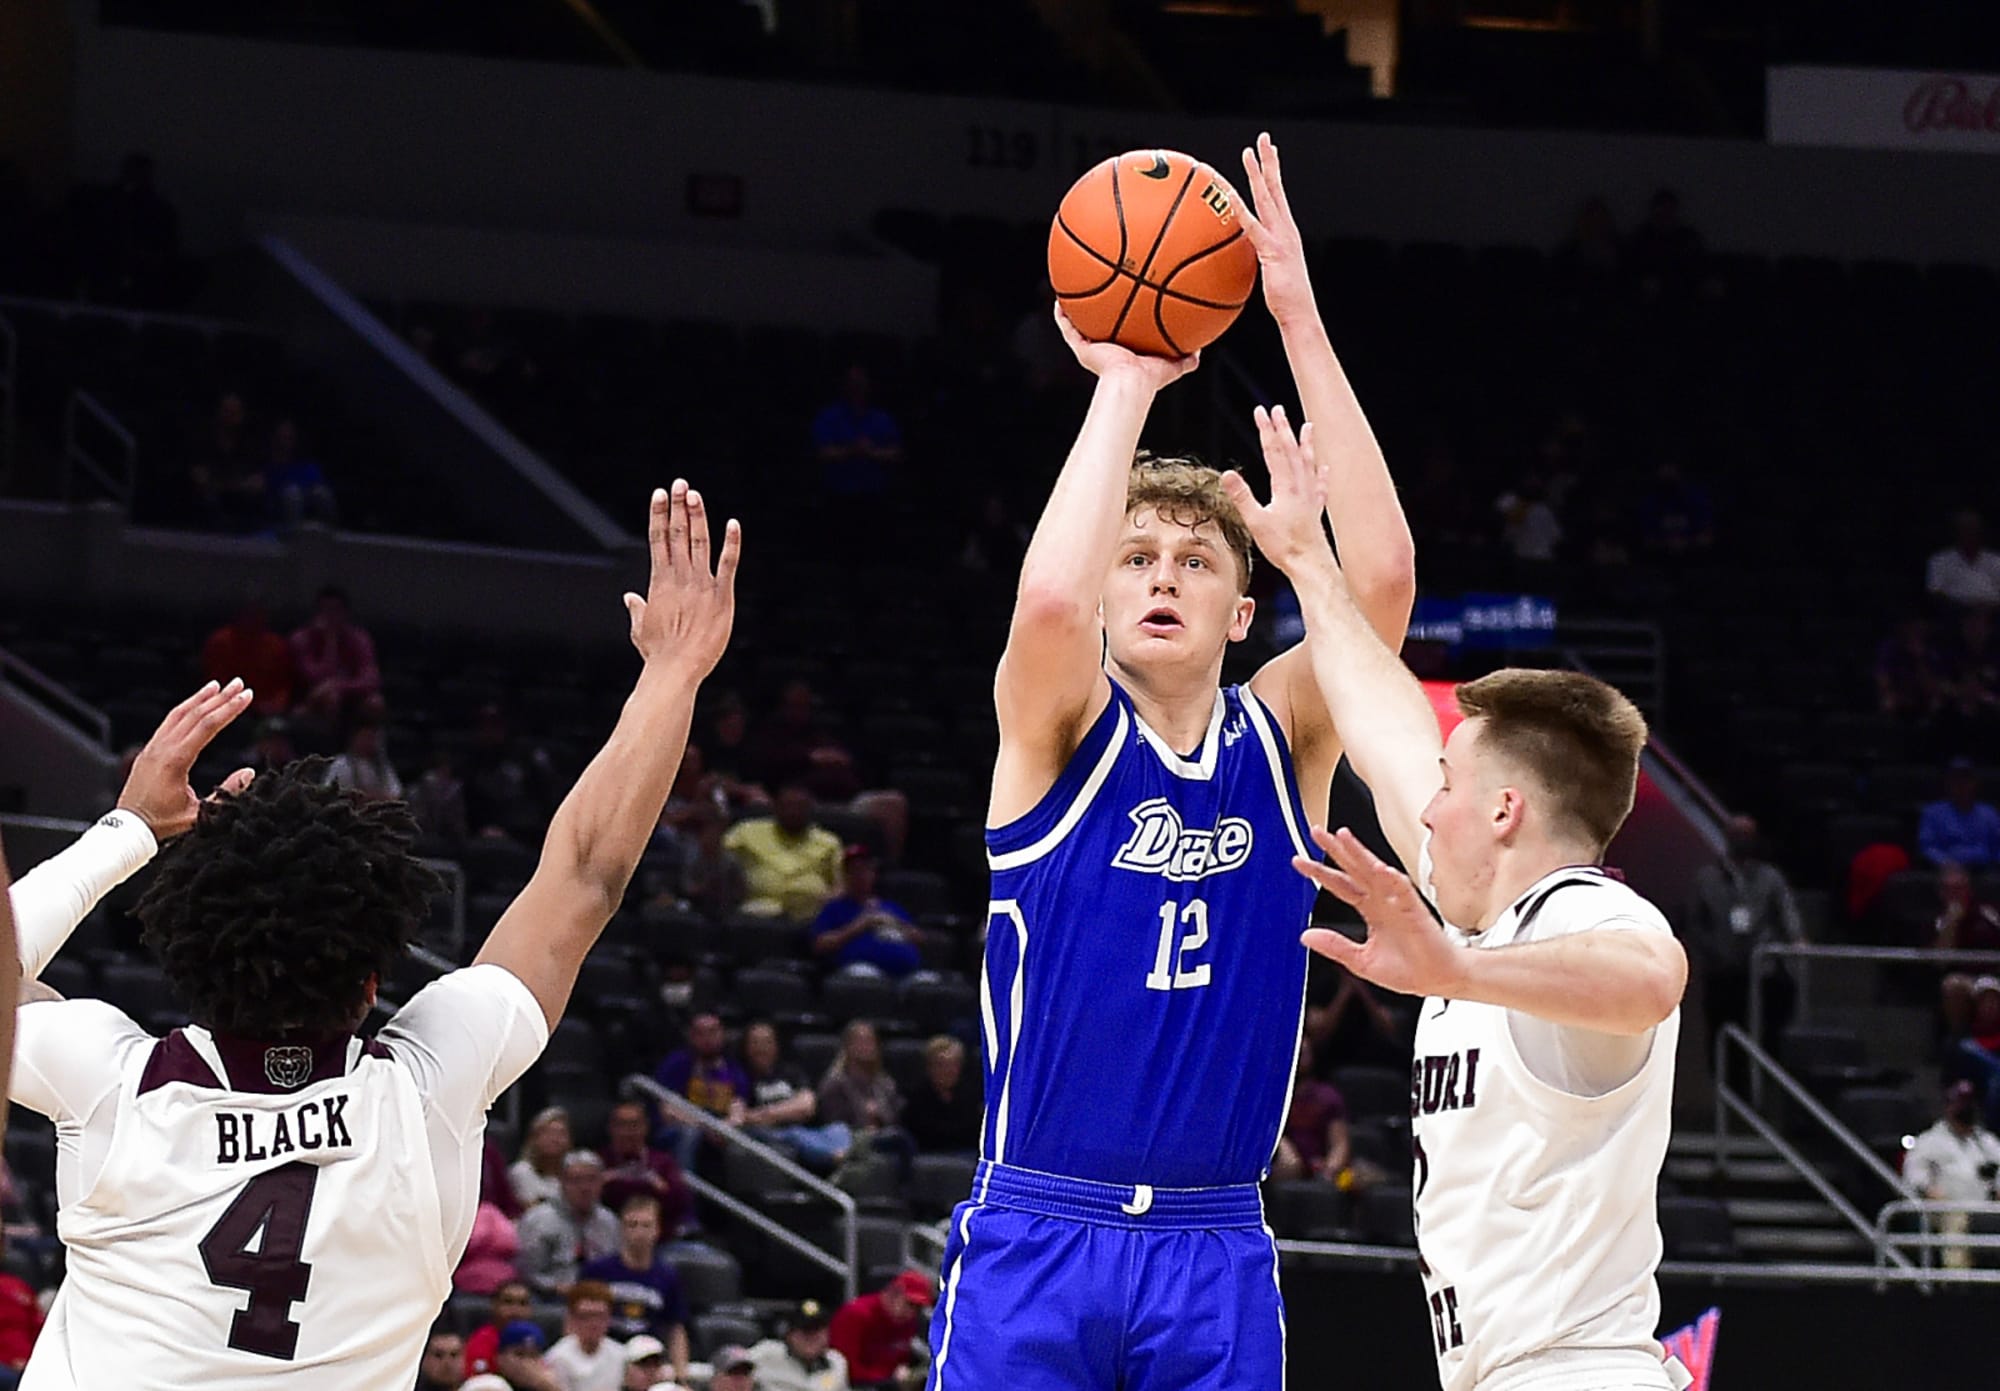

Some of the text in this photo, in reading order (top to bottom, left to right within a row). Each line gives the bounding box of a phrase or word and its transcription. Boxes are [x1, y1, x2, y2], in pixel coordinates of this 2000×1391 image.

[1112, 798, 1253, 881] Drae
[1146, 898, 1211, 990] 12
[215, 1095, 352, 1163] BLACK
[198, 1161, 318, 1360] 4
